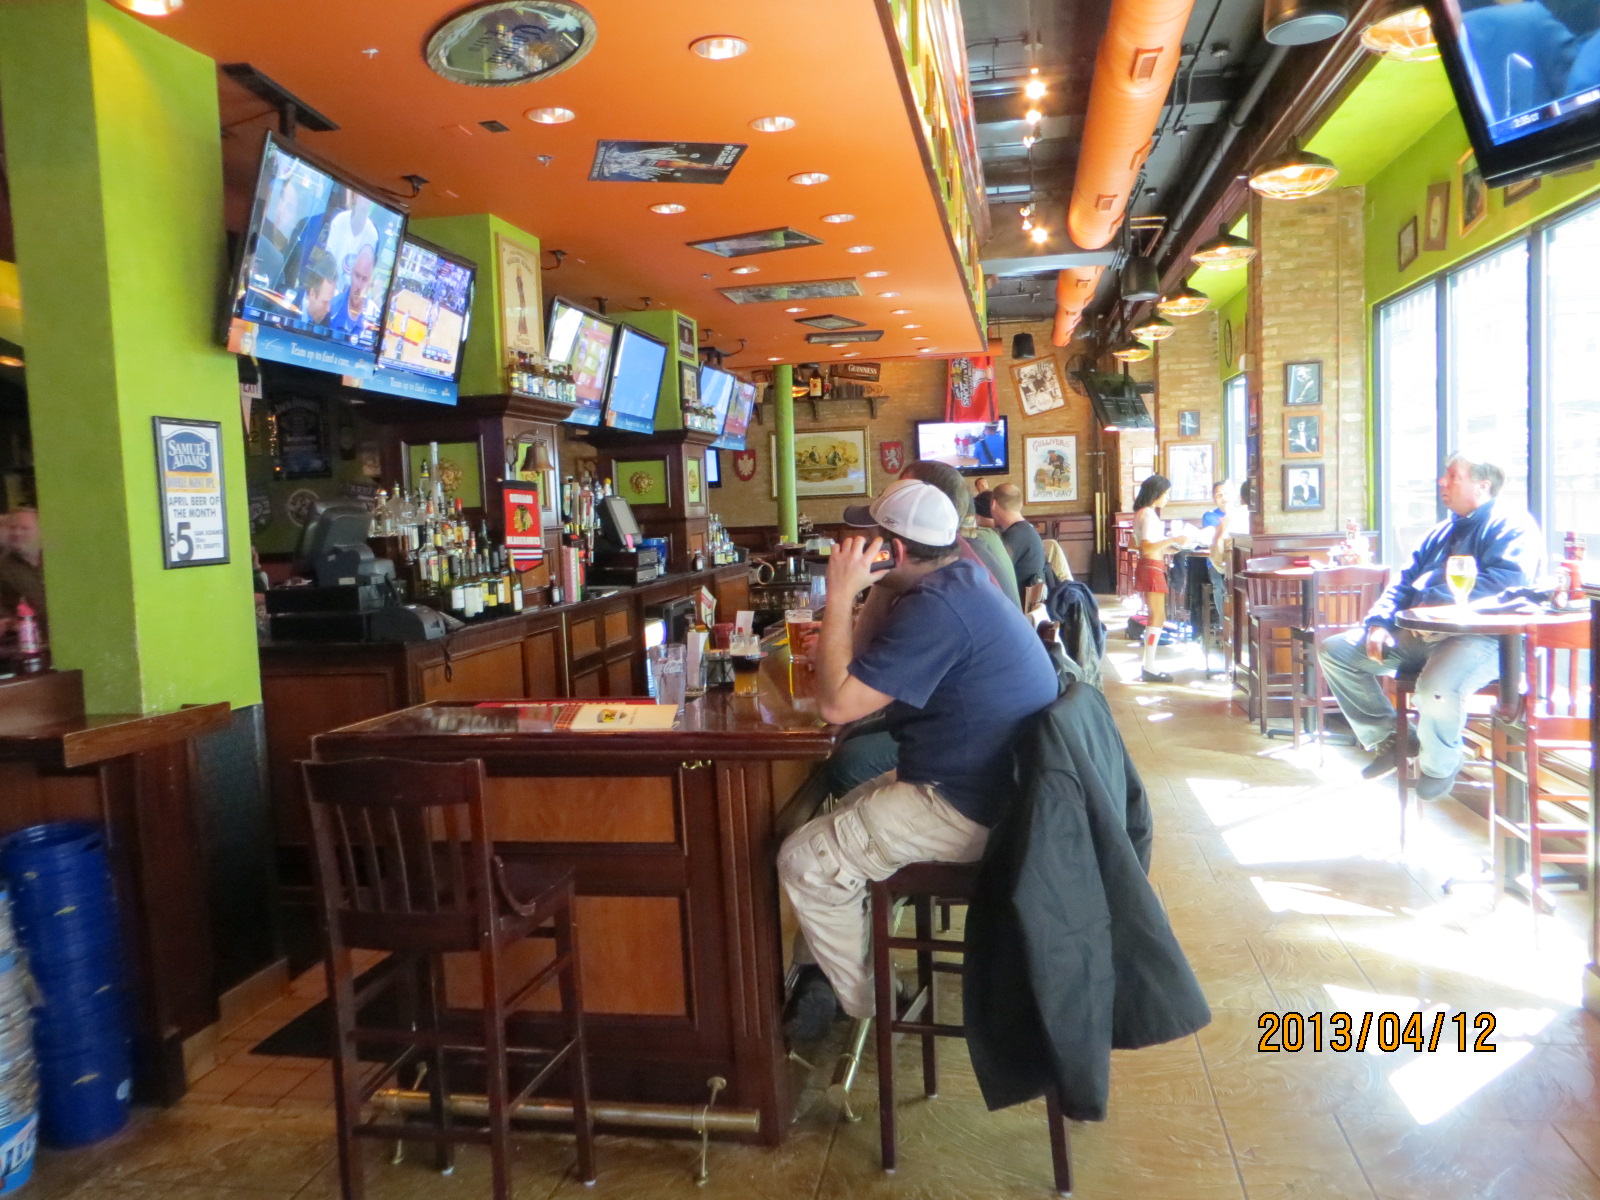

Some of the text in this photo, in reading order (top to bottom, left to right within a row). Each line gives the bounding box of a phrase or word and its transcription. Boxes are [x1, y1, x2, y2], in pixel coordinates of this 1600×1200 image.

[848, 363, 878, 376] GUINNESS
[168, 440, 210, 456] SAMUEL
[173, 455, 208, 470] ADAMS
[169, 496, 220, 506] APRIL BEER OF
[173, 508, 217, 518] THE MONTH
